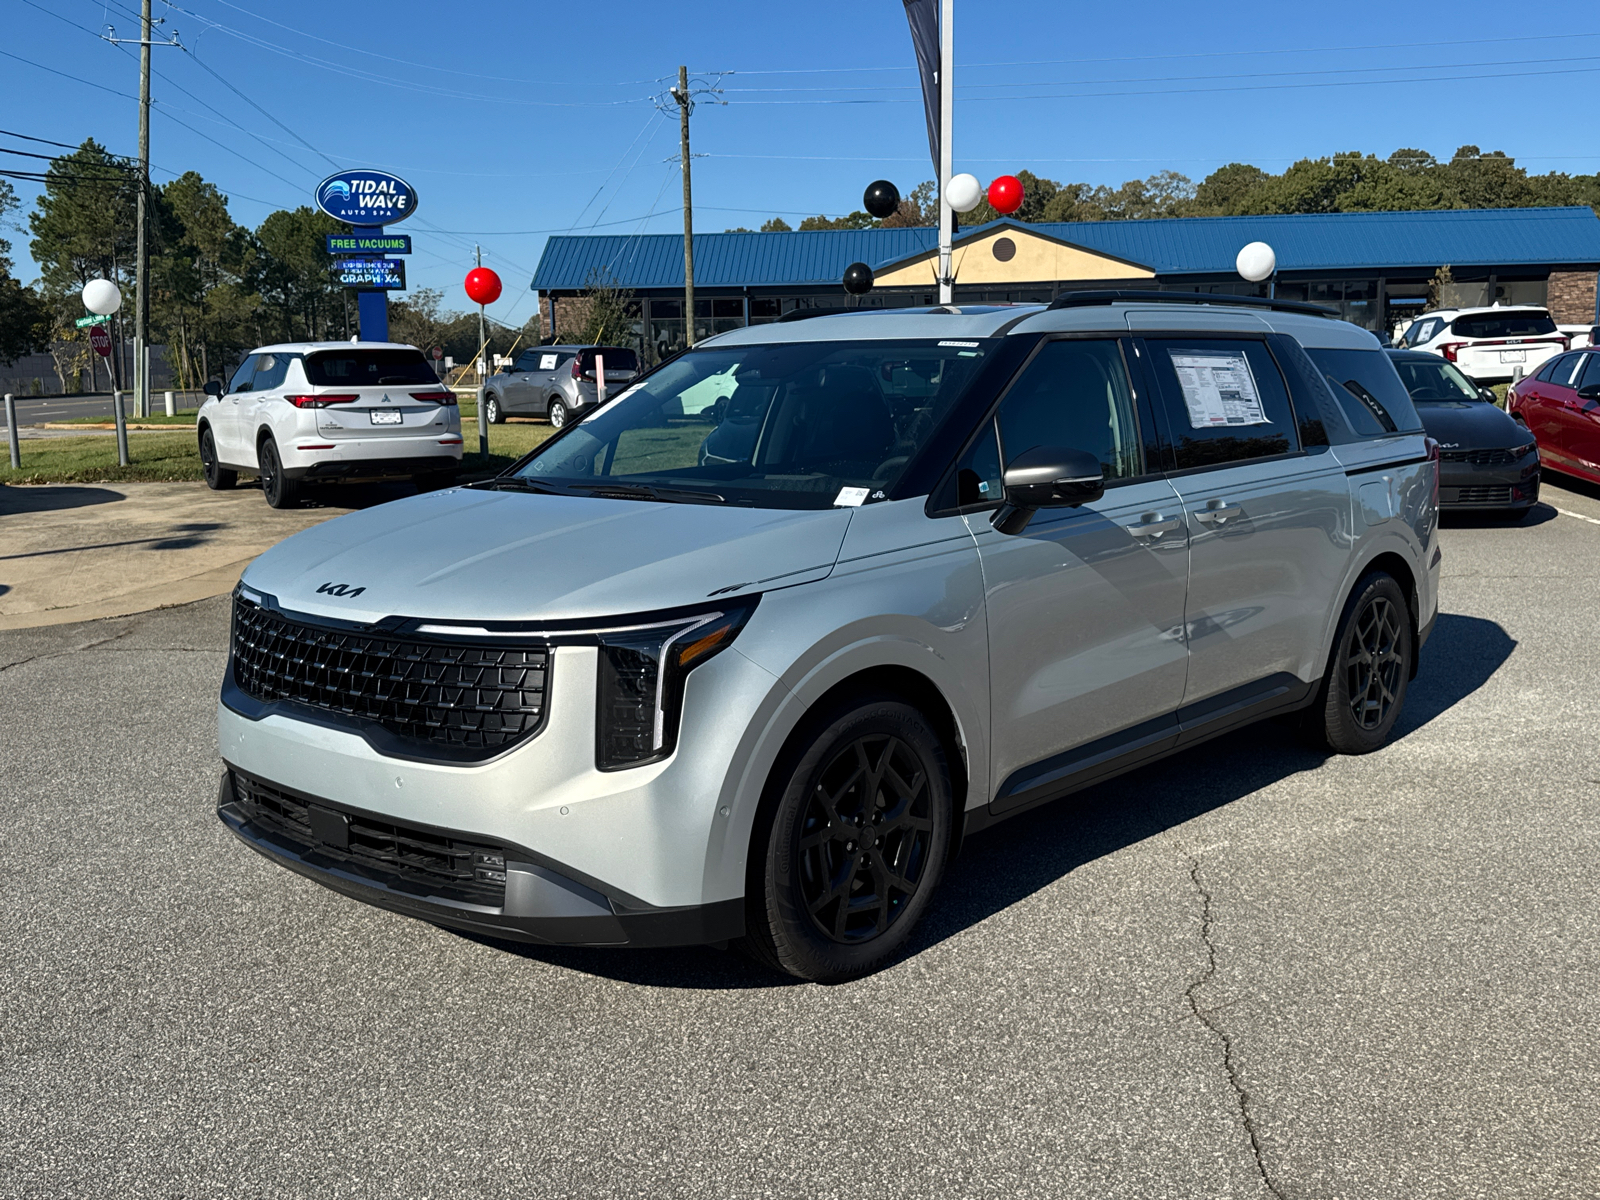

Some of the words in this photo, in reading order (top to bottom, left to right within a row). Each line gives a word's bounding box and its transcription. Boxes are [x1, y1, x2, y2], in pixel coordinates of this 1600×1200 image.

[350, 180, 396, 194] TIDAL
[359, 194, 407, 208] WAVE
[330, 239, 356, 248] FREE
[359, 239, 405, 248] VACUUMS
[92, 336, 109, 347] STOP
